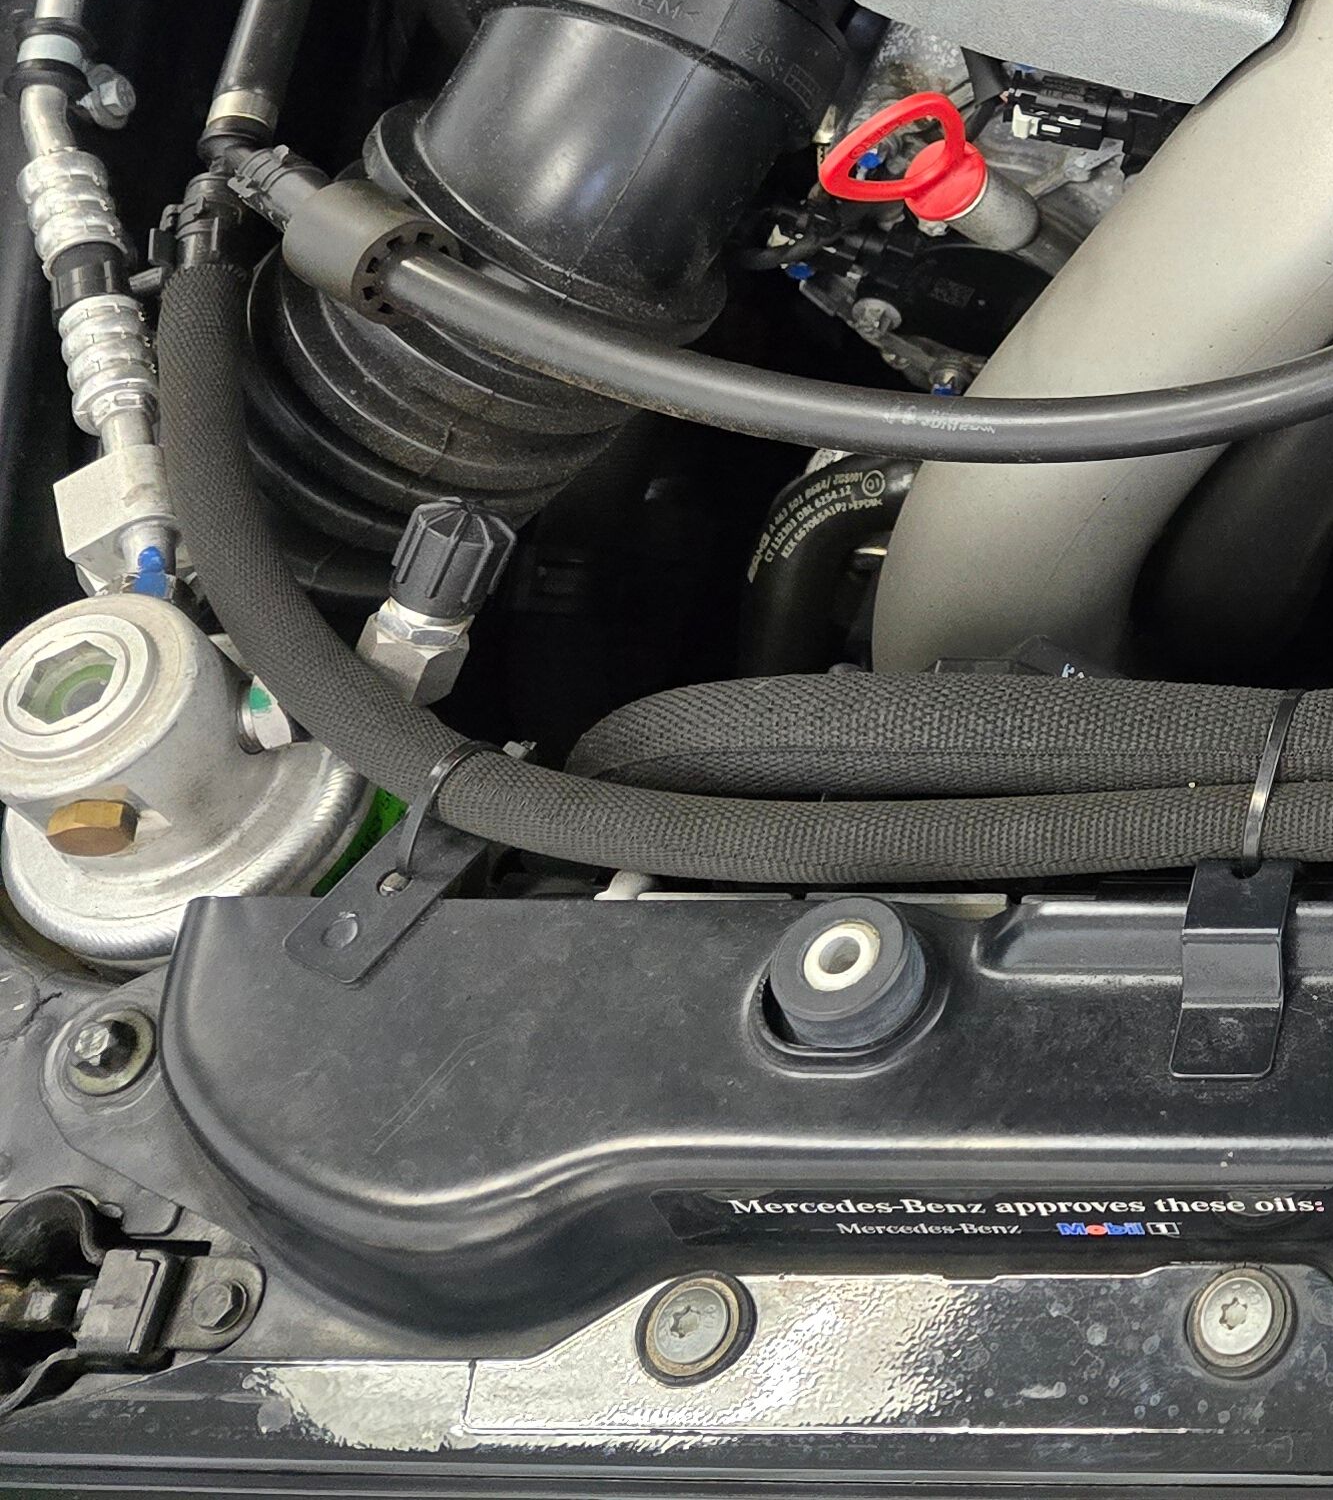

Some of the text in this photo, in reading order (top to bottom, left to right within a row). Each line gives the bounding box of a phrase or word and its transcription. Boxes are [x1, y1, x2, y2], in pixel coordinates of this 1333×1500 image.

[728, 1197, 1325, 1217] Mercedes-Benz approves these oils:
[836, 1222, 1022, 1235] Mercedes-Benz
[1057, 1222, 1146, 1236] Mobil
